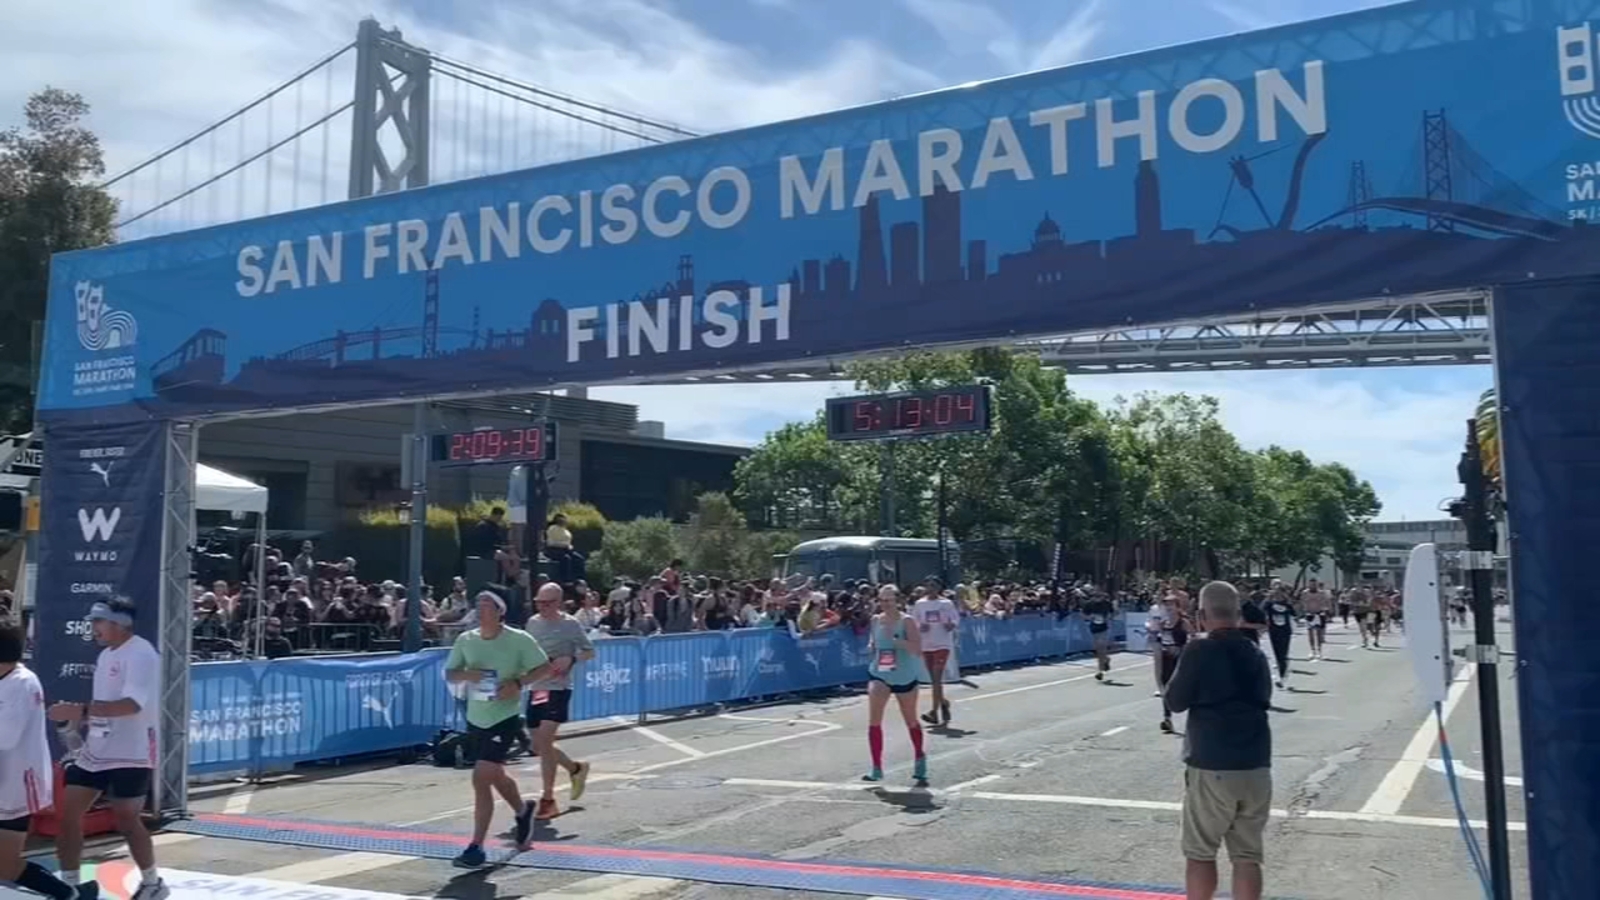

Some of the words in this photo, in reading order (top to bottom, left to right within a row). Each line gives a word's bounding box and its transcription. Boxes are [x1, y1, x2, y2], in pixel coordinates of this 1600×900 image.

[235, 231, 342, 297] SAN
[362, 166, 751, 278] FRANCISCO
[779, 60, 1327, 219] MARATHON
[566, 283, 791, 363] FINISH
[74, 366, 136, 385] MARATHON
[74, 551, 117, 561] WAYMO
[190, 709, 220, 721] SAN
[224, 701, 301, 720] FRANCISCO
[188, 716, 301, 744] MARATHON
